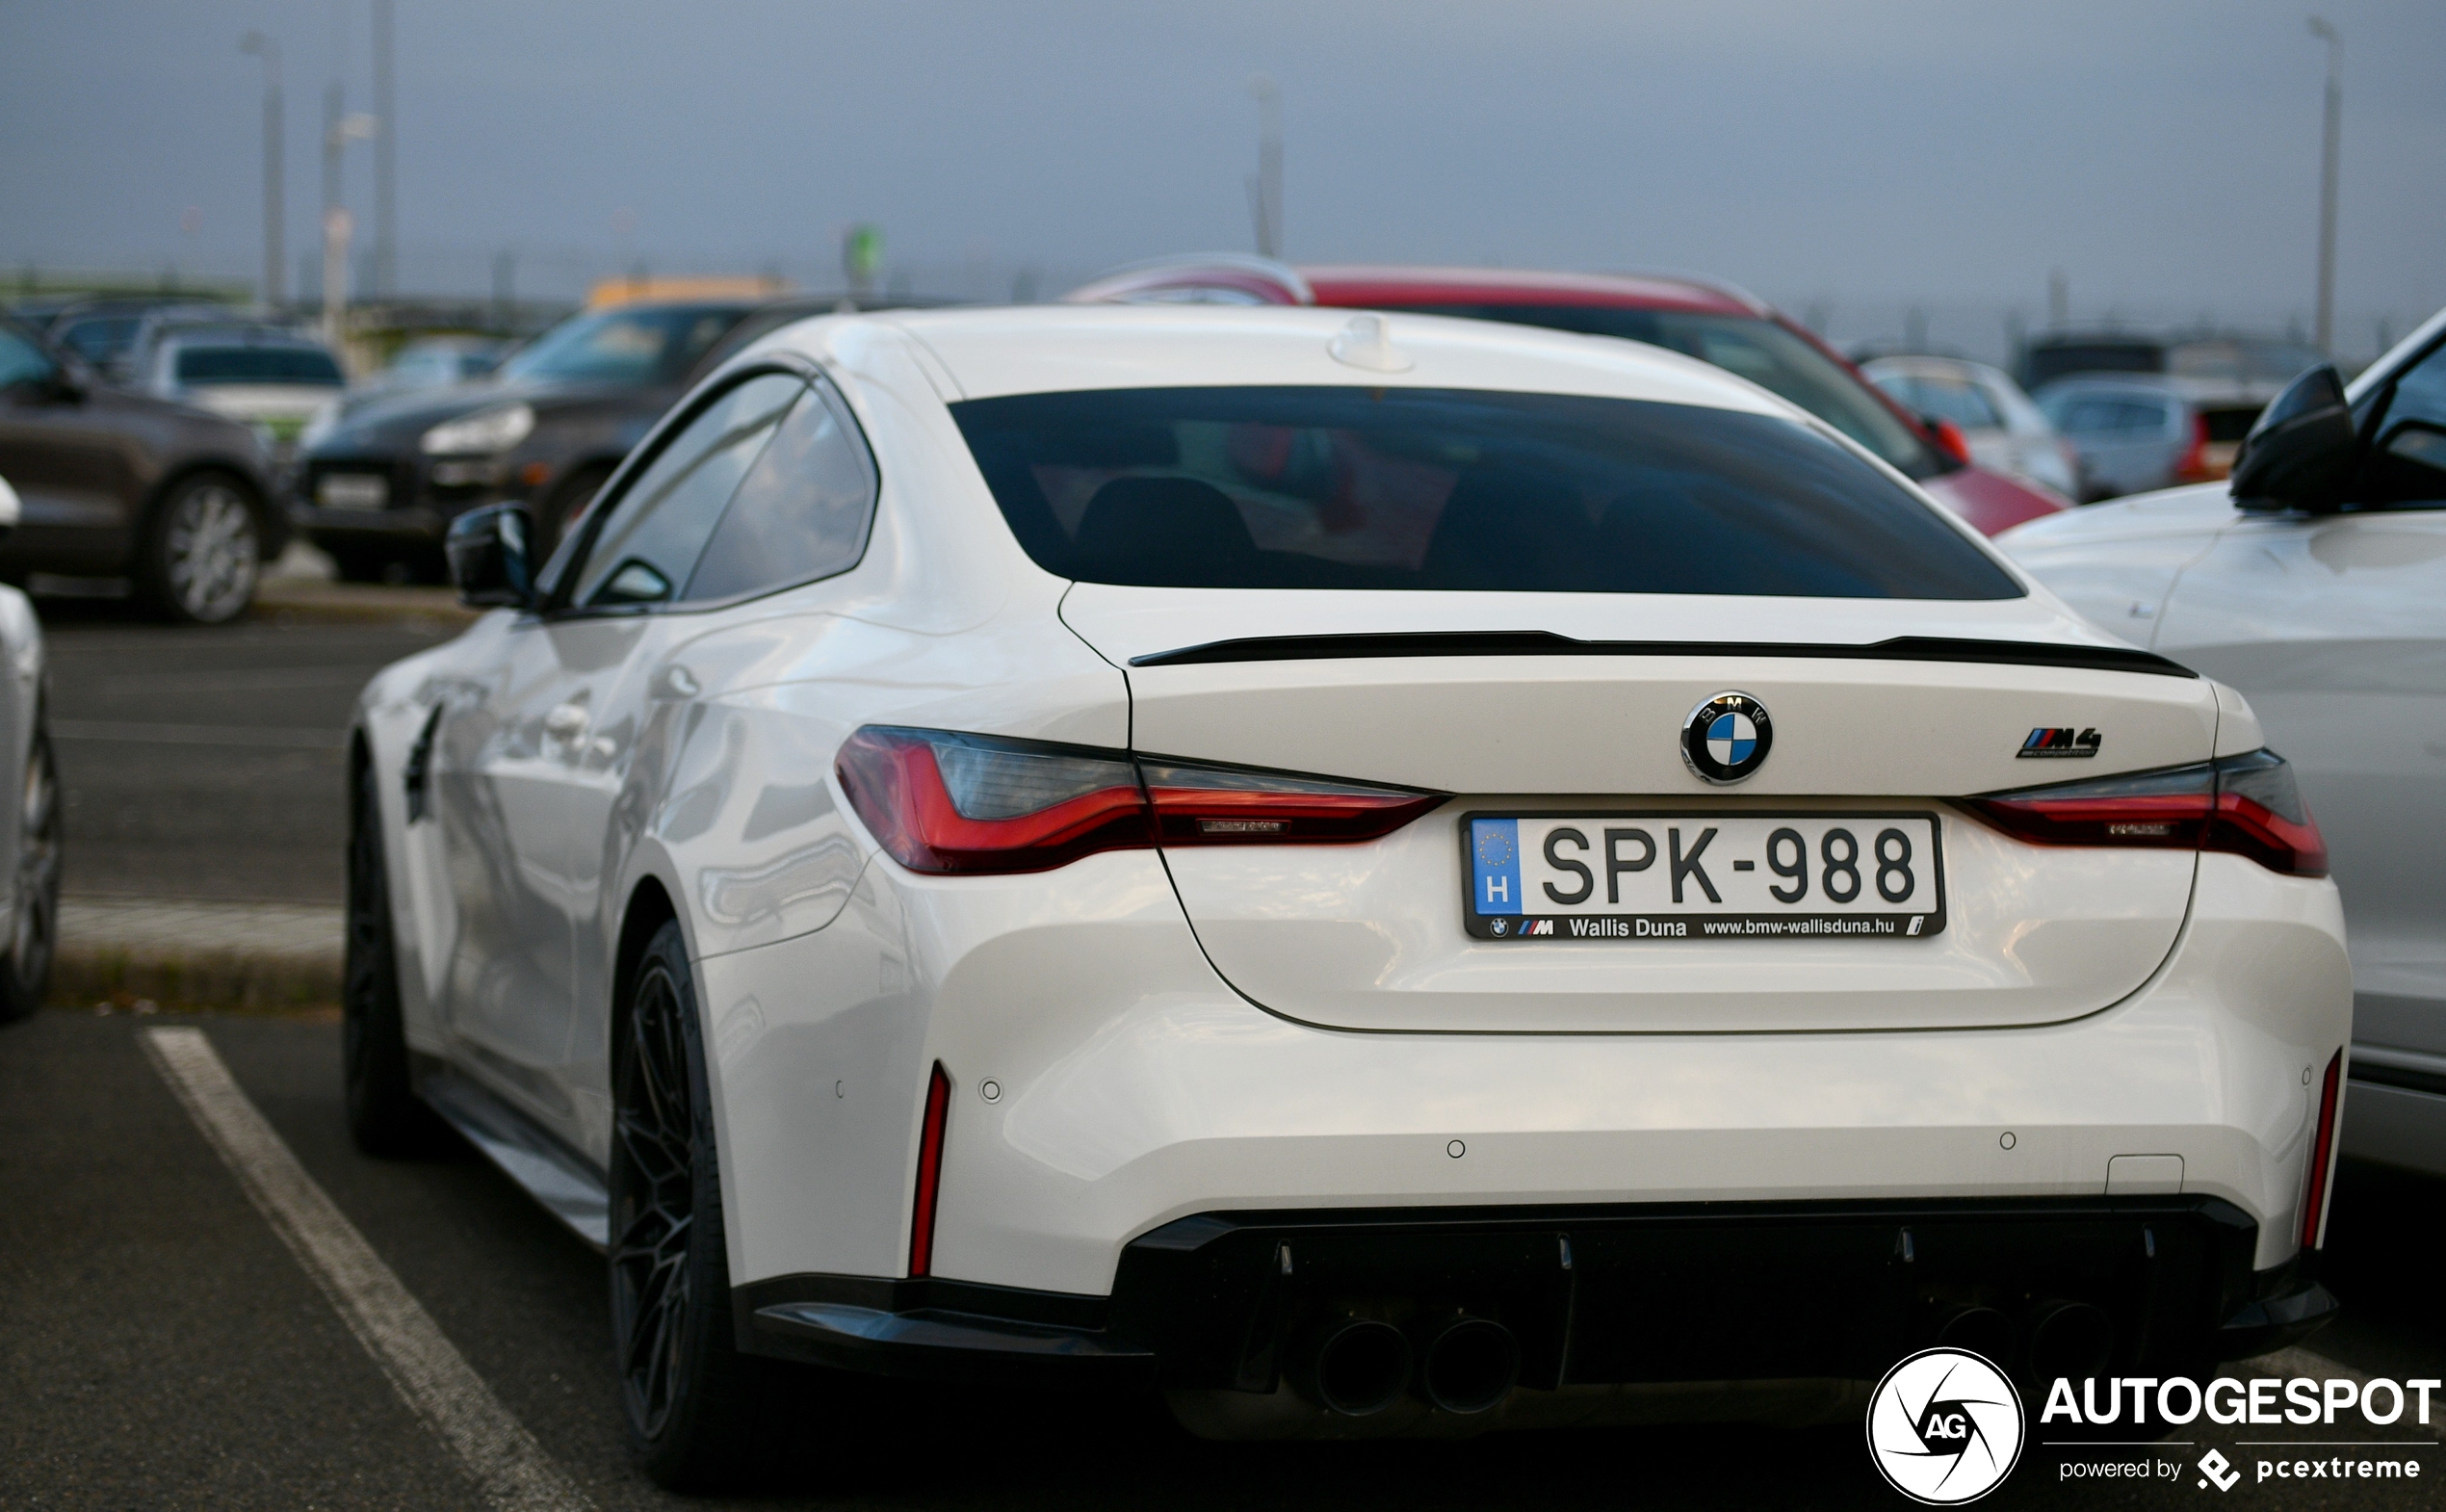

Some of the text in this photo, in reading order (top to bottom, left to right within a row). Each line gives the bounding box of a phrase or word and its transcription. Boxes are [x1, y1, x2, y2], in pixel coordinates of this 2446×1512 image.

[1699, 696, 1767, 724] BMW
[2040, 727, 2102, 748] M4
[1542, 827, 1915, 904] SPK-988
[1486, 875, 1509, 903] H
[1569, 918, 1687, 937] Wallis Duna
[1703, 918, 1895, 935] www.bmw-wallisduna.hu
